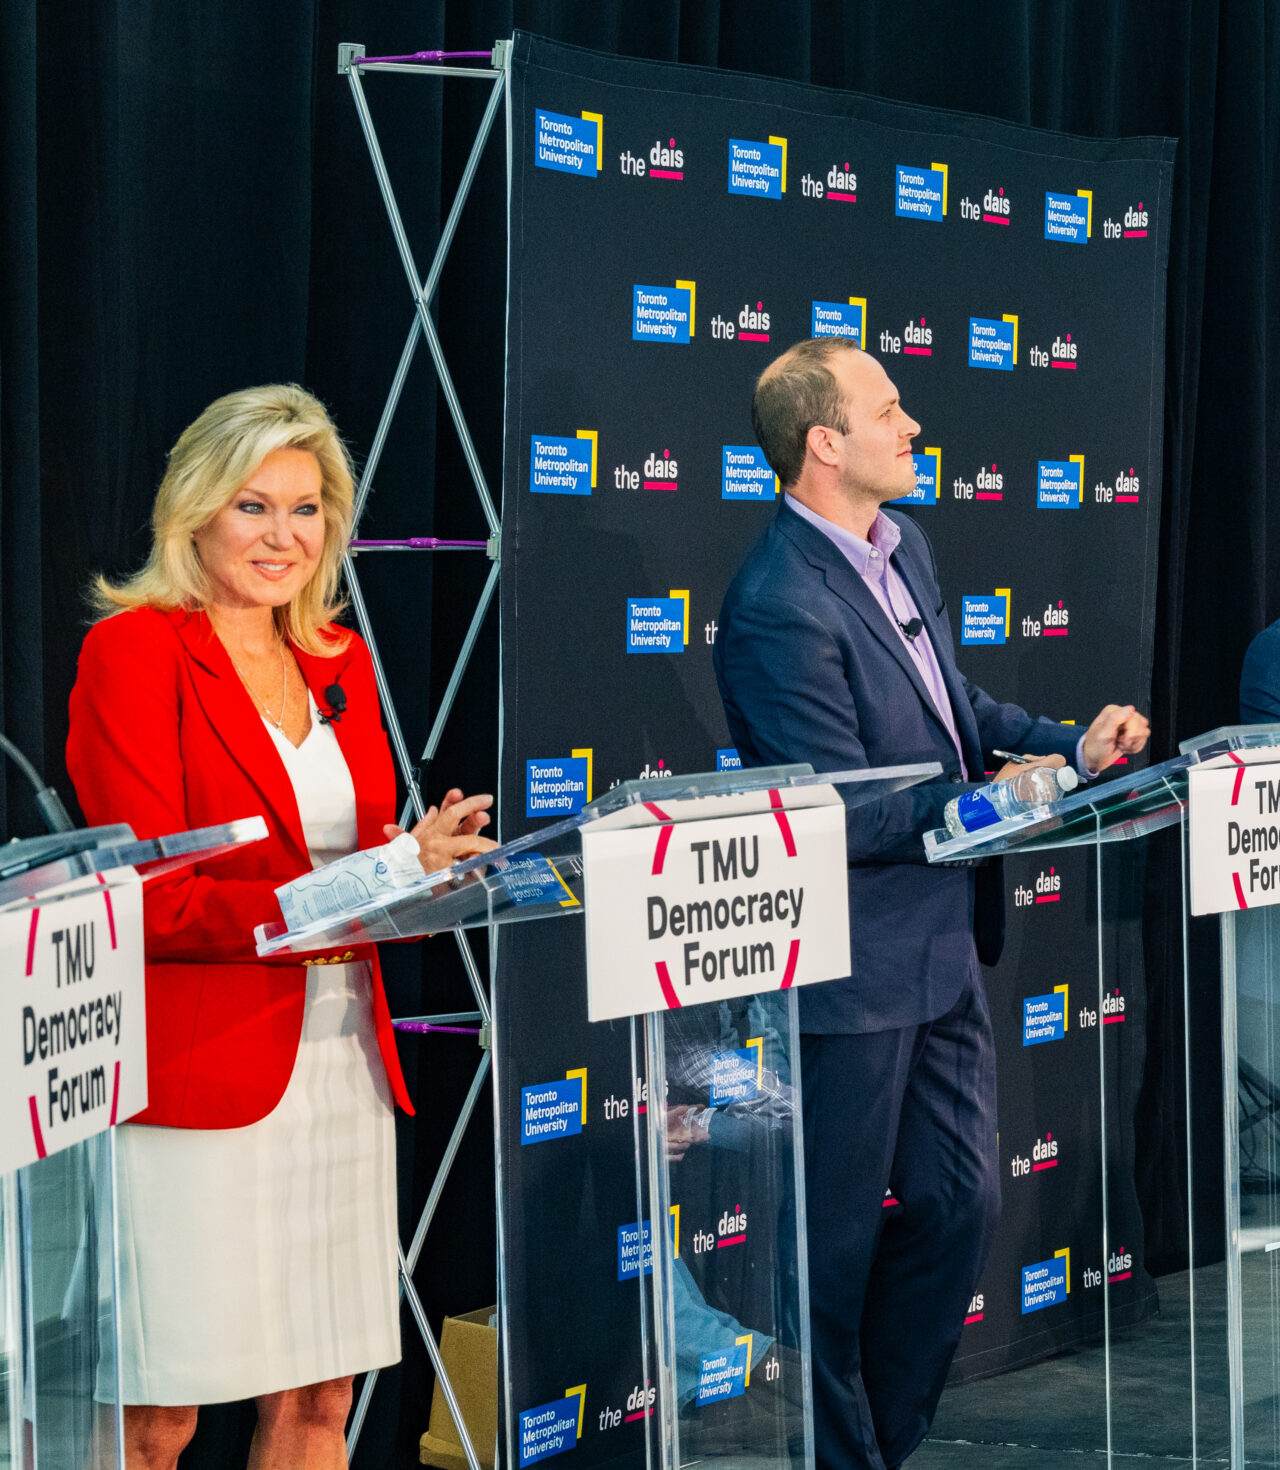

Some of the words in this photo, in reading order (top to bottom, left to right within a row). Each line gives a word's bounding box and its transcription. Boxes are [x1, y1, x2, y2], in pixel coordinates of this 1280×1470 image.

[539, 115, 572, 134] Toronto
[539, 131, 593, 153] Metropolitan
[539, 146, 582, 169] University
[620, 151, 645, 176] the
[650, 138, 683, 168] dais
[732, 145, 760, 160] Toronto
[732, 159, 778, 177] Metropolitan
[732, 174, 769, 192] University
[801, 174, 823, 198] the
[827, 162, 856, 191] dais
[899, 170, 924, 185] Toronto
[899, 184, 940, 200] Metropolitan
[899, 198, 932, 215] University
[960, 197, 980, 221] the
[983, 188, 1010, 215] dais
[1048, 197, 1071, 210] Toronto
[1048, 210, 1085, 225] Metropolitan
[1103, 218, 1121, 238] the
[1124, 202, 1148, 228] dais
[1048, 222, 1077, 238] University
[637, 291, 667, 305] Toronto
[637, 305, 687, 322] Metropolitan
[711, 316, 734, 340] the
[738, 301, 770, 331] dais
[815, 307, 841, 321] Toronto
[636, 320, 676, 337] University
[815, 322, 858, 338] Metropolitan
[880, 330, 900, 353] the
[904, 318, 932, 345] dais
[972, 323, 996, 336] Toronto
[972, 336, 1011, 351] Metropolitan
[1030, 346, 1048, 368] the
[1052, 334, 1077, 359] dais
[972, 349, 1003, 365] University
[535, 442, 567, 455] Toronto
[535, 457, 588, 473] Metropolitan
[726, 451, 755, 464] Toronto
[614, 464, 639, 490] the
[644, 449, 677, 478] dais
[726, 466, 773, 481] Metropolitan
[1041, 466, 1063, 477] Toronto
[534, 472, 577, 489] University
[725, 480, 763, 495] University
[954, 477, 973, 499] the
[977, 464, 1002, 490] dais
[1040, 479, 1077, 492] Metropolitan
[1095, 482, 1112, 502] the
[1116, 468, 1139, 492] dais
[1040, 491, 1070, 504] University
[631, 604, 661, 616] Toronto
[965, 601, 989, 612] Toronto
[631, 619, 681, 634] Metropolitan
[965, 614, 1003, 627] Metropolitan
[1022, 616, 1040, 636] the
[1044, 600, 1068, 625] dais
[631, 633, 671, 647] University
[705, 620, 718, 644] th
[964, 627, 996, 639] University
[720, 755, 741, 767] Toron
[530, 766, 563, 778] Toronto
[531, 779, 583, 795] Metropolitan
[531, 794, 573, 809] University
[690, 835, 758, 884] TMU
[1015, 886, 1033, 907] the
[1036, 867, 1060, 892] dais
[647, 886, 804, 940] Democracy
[52, 921, 94, 988] TMU
[684, 941, 775, 986] Forum
[1026, 1002, 1048, 1013] Toronto
[1079, 1007, 1096, 1028] the
[1103, 988, 1124, 1014] dais
[1026, 1011, 1062, 1026] Metropolitan
[22, 991, 122, 1066] Democracy
[1026, 1024, 1055, 1038] University
[48, 1064, 106, 1128] Forum
[525, 1091, 558, 1105] Toronto
[525, 1102, 578, 1120] Metropolitan
[604, 1095, 628, 1120] the
[525, 1118, 568, 1135] University
[1012, 1155, 1030, 1177] the
[1033, 1132, 1058, 1160] dais
[621, 1229, 651, 1243] Toroto
[694, 1230, 714, 1253] the
[718, 1204, 747, 1235] dais
[1025, 1268, 1049, 1281] Toronto
[1083, 1268, 1101, 1288] the
[1108, 1246, 1132, 1272] dais
[1025, 1276, 1064, 1294] Metropolitan
[1025, 1289, 1056, 1306] University
[704, 1356, 729, 1369] Toronto
[766, 1357, 779, 1381] th
[702, 1365, 744, 1384] Metropolitan
[700, 1380, 734, 1398] University
[524, 1412, 557, 1430] Toronto
[599, 1406, 621, 1430] the
[524, 1420, 575, 1445] Metropolitan
[524, 1437, 564, 1459] University
